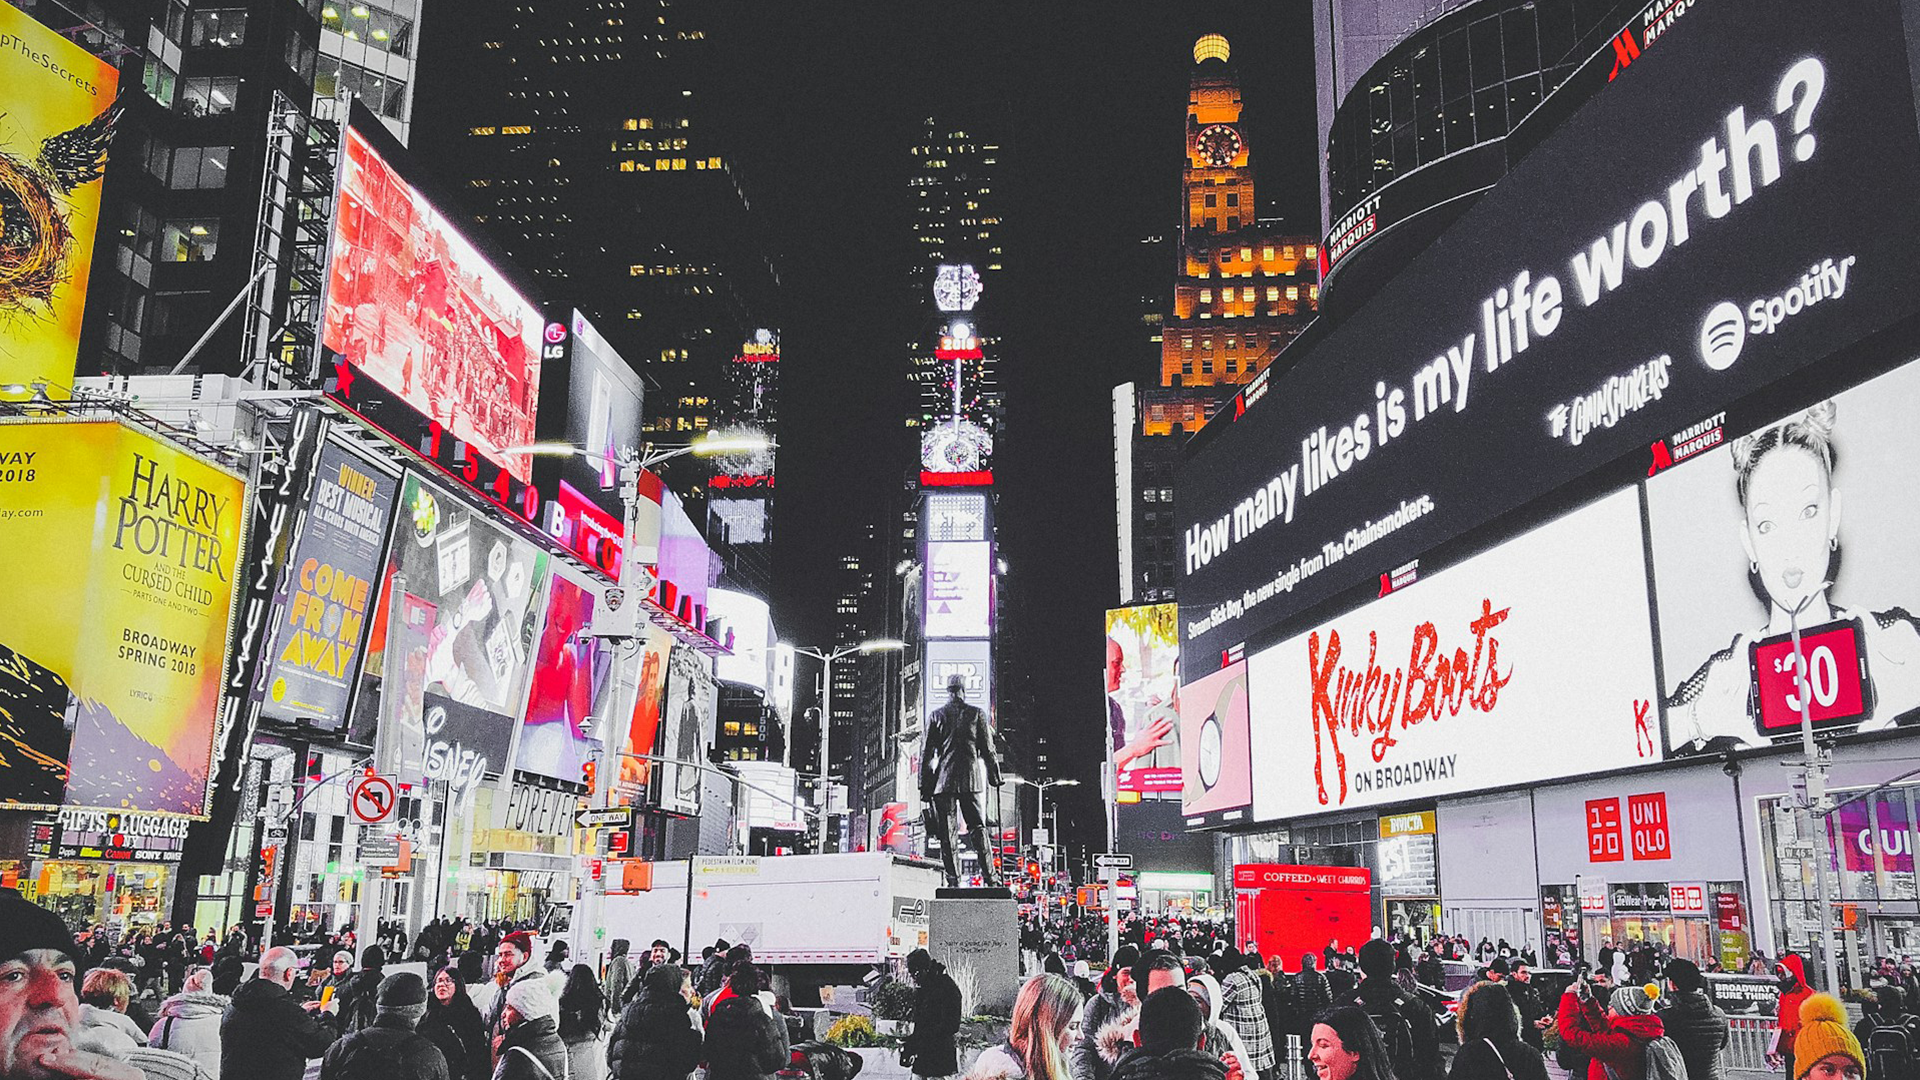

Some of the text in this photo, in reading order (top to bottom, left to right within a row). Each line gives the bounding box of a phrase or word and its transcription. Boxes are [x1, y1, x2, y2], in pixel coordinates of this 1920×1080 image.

[0, 34, 98, 96] pTheSecrets
[1330, 195, 1381, 247] MARRIOTT
[1331, 218, 1374, 263] MARQUIS
[1748, 257, 1850, 335] Spotify
[1185, 57, 1825, 575] How many likes is my life worth?
[544, 345, 564, 359] LG
[1672, 411, 1726, 445] MARRIOTT
[1675, 429, 1722, 459] MARQUIS
[128, 452, 230, 537] HARRY
[316, 478, 346, 513] BEST
[0, 508, 43, 521] ay.com
[342, 491, 383, 534] MUSICAL
[112, 496, 227, 582] POTTER
[153, 562, 186, 580] AND THE
[299, 557, 369, 604] COME
[1188, 494, 1435, 640] Stream Sick Boy, the new single from The Chainsmokers.
[122, 563, 213, 606] CURSED CHILD
[132, 589, 198, 616] PARTS ONE AND TWO
[122, 628, 197, 659] BROADWAY
[279, 631, 356, 679] AWAY
[117, 645, 196, 676] SPRING 2018
[1308, 598, 1514, 806] Kinky Boots
[1355, 754, 1457, 794] ON BROADWAY
[58, 810, 107, 833] GIFTS
[118, 815, 190, 839] LUGGAGE
[608, 814, 625, 822] WAY
[1390, 815, 1424, 833] INVICTA
[1633, 800, 1662, 824] UNI
[105, 848, 133, 860] Canon
[135, 850, 162, 861] SONY
[1634, 828, 1666, 854] QLO
[1316, 874, 1337, 885] SWEET
[1643, 894, 1669, 911] Pop-Up
[1715, 983, 1779, 993] BROADWAY'S
[1715, 991, 1743, 1000] SURE
